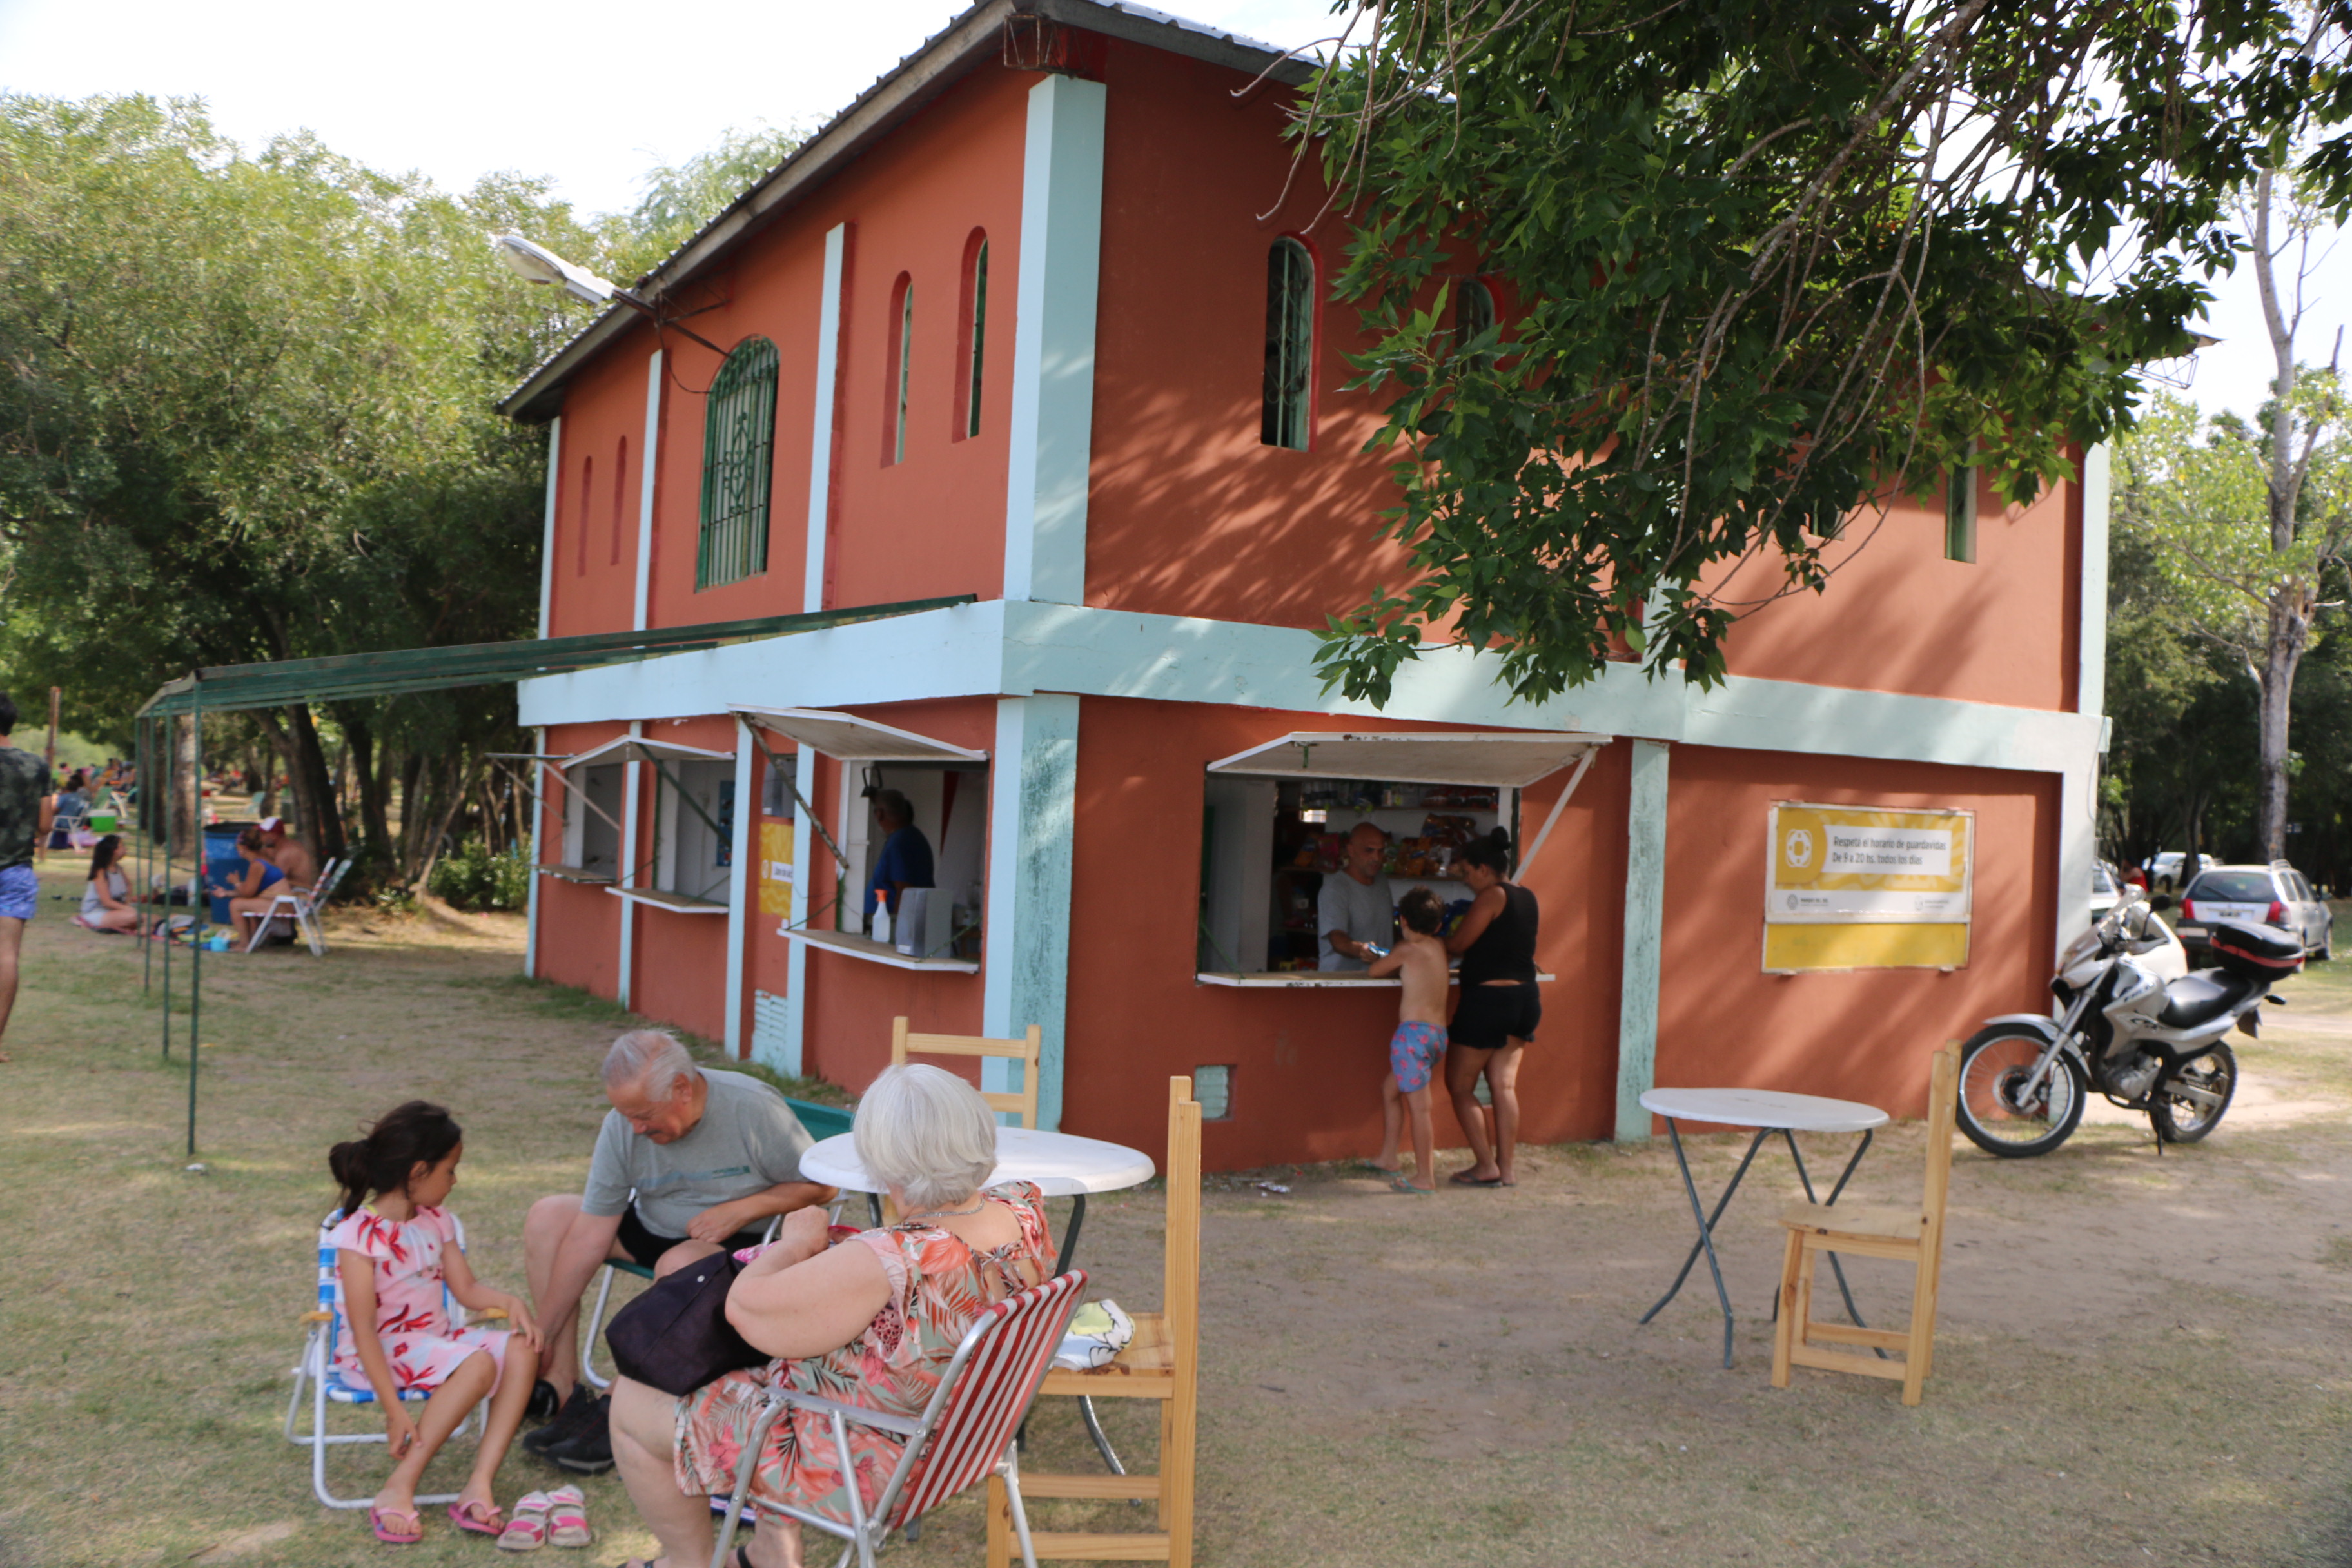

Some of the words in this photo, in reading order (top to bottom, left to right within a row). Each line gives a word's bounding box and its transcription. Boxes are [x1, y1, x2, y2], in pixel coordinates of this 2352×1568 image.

[1863, 837, 1868, 847] el
[1870, 838, 1895, 848] horario
[1896, 838, 1905, 848] de
[1906, 839, 1946, 850] guardavidas
[1832, 852, 1841, 862] De
[1843, 852, 1848, 863] 9
[1856, 852, 1864, 863] 20
[1866, 853, 1875, 863] hs.
[1877, 853, 1897, 864] todos
[1898, 854, 1908, 865] los
